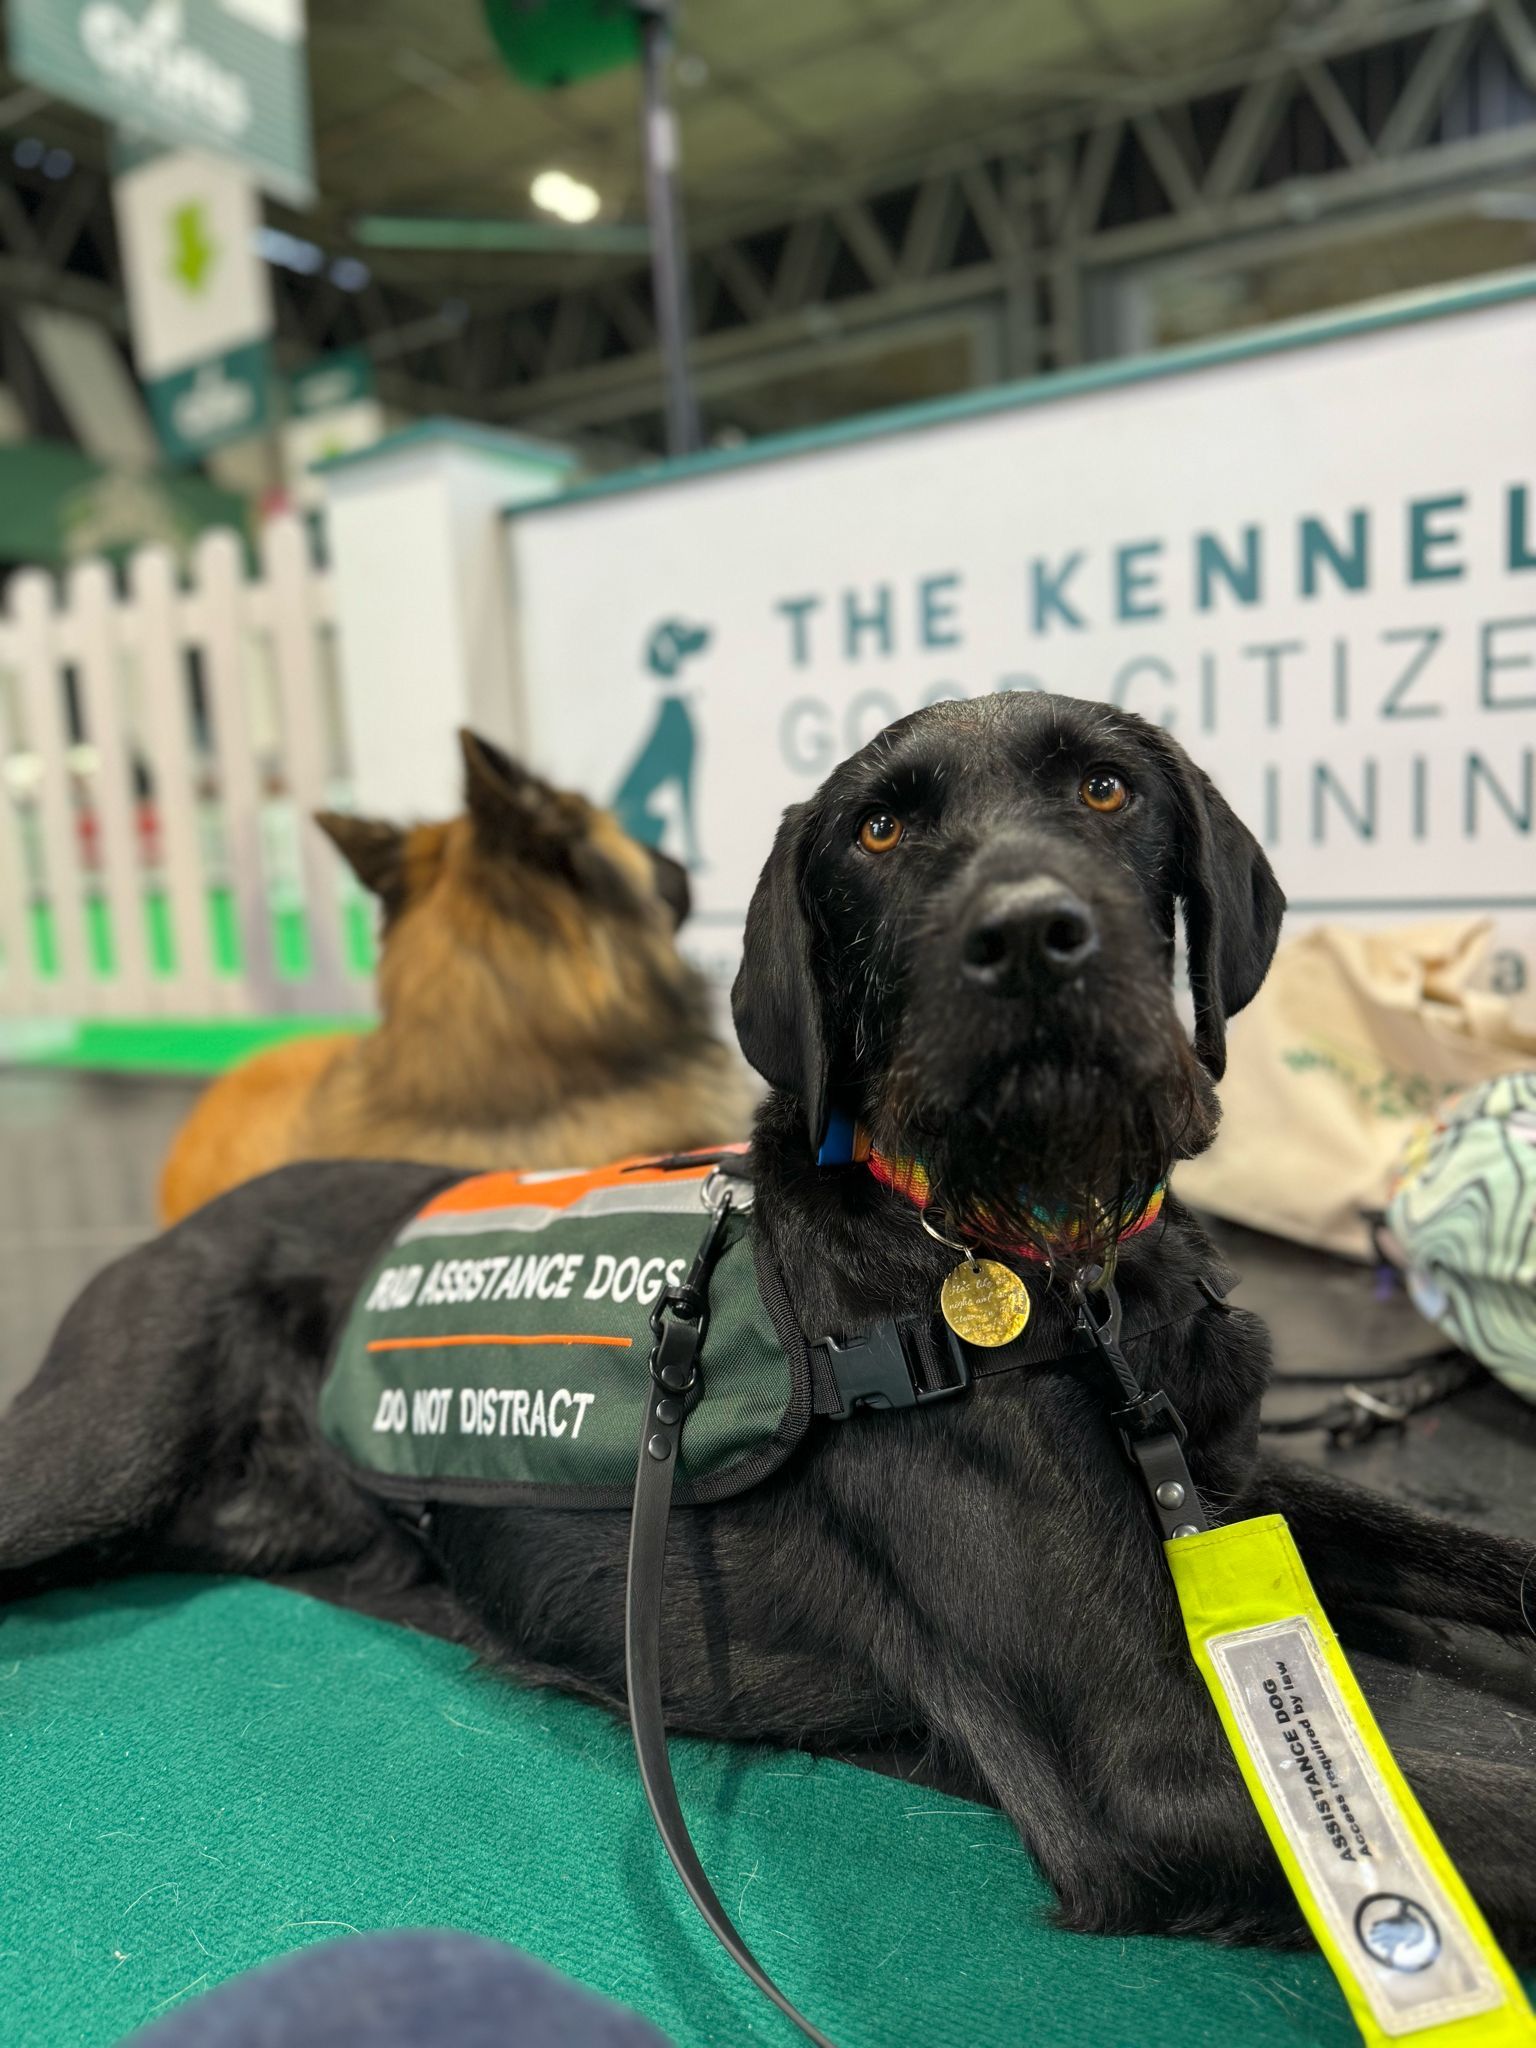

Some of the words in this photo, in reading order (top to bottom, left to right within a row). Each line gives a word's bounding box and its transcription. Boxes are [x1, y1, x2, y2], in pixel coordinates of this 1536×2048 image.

[776, 570, 963, 668] THE
[1030, 482, 1536, 636] KENNEL
[416, 1253, 585, 1308] ASSISTANCE
[583, 1254, 686, 1305] DOGS
[372, 1388, 408, 1434] DO
[412, 1388, 453, 1435] NOT
[460, 1387, 595, 1439] DISTRACT
[1262, 1678, 1291, 1724] DOG
[1275, 1661, 1295, 1692] law
[1289, 1695, 1305, 1715] by
[1297, 1718, 1339, 1789] required
[1282, 1729, 1357, 1862] ASSISTANCE
[1335, 1793, 1373, 1857] Access
